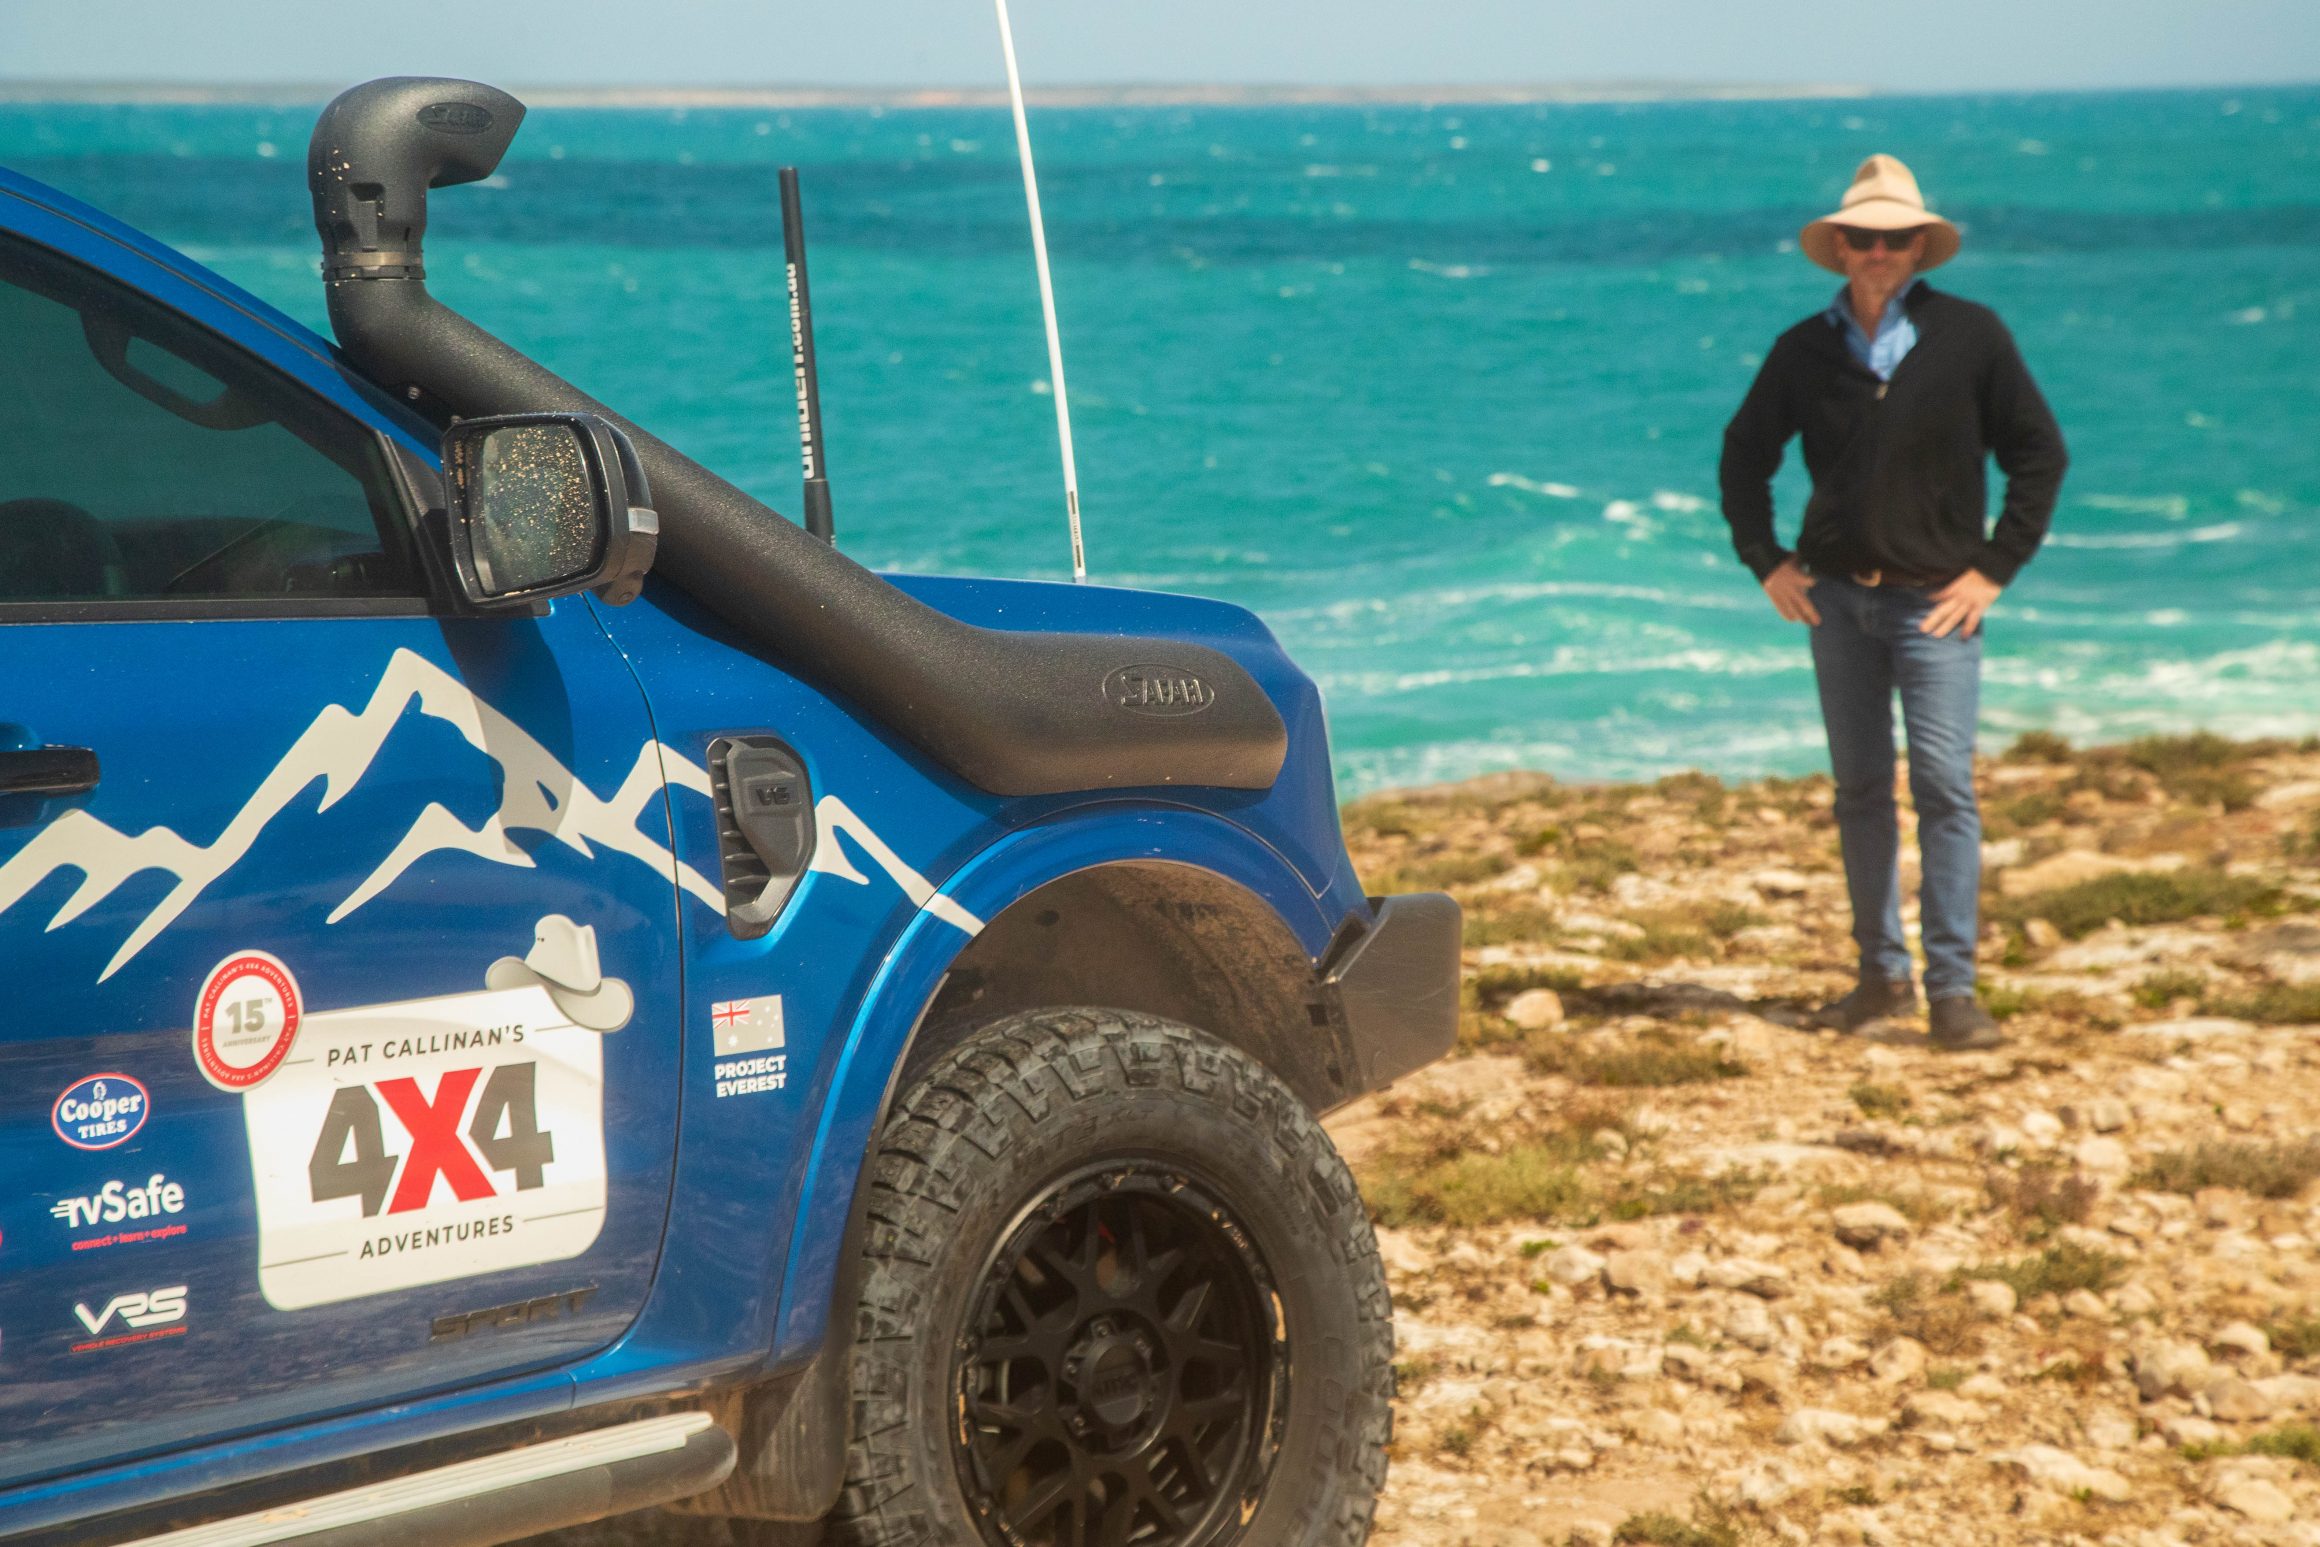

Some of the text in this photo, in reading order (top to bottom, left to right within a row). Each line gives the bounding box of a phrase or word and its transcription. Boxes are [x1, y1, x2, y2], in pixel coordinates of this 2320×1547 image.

[327, 1025, 524, 1067] PAT CALLINAN'S
[714, 1054, 787, 1080] PROJECT
[716, 1072, 787, 1098] EVEREST
[60, 1094, 143, 1122] Cooper
[77, 1119, 127, 1139] TIRES
[309, 1061, 554, 1218] 4X4
[360, 1215, 514, 1260] ADVENTURES
